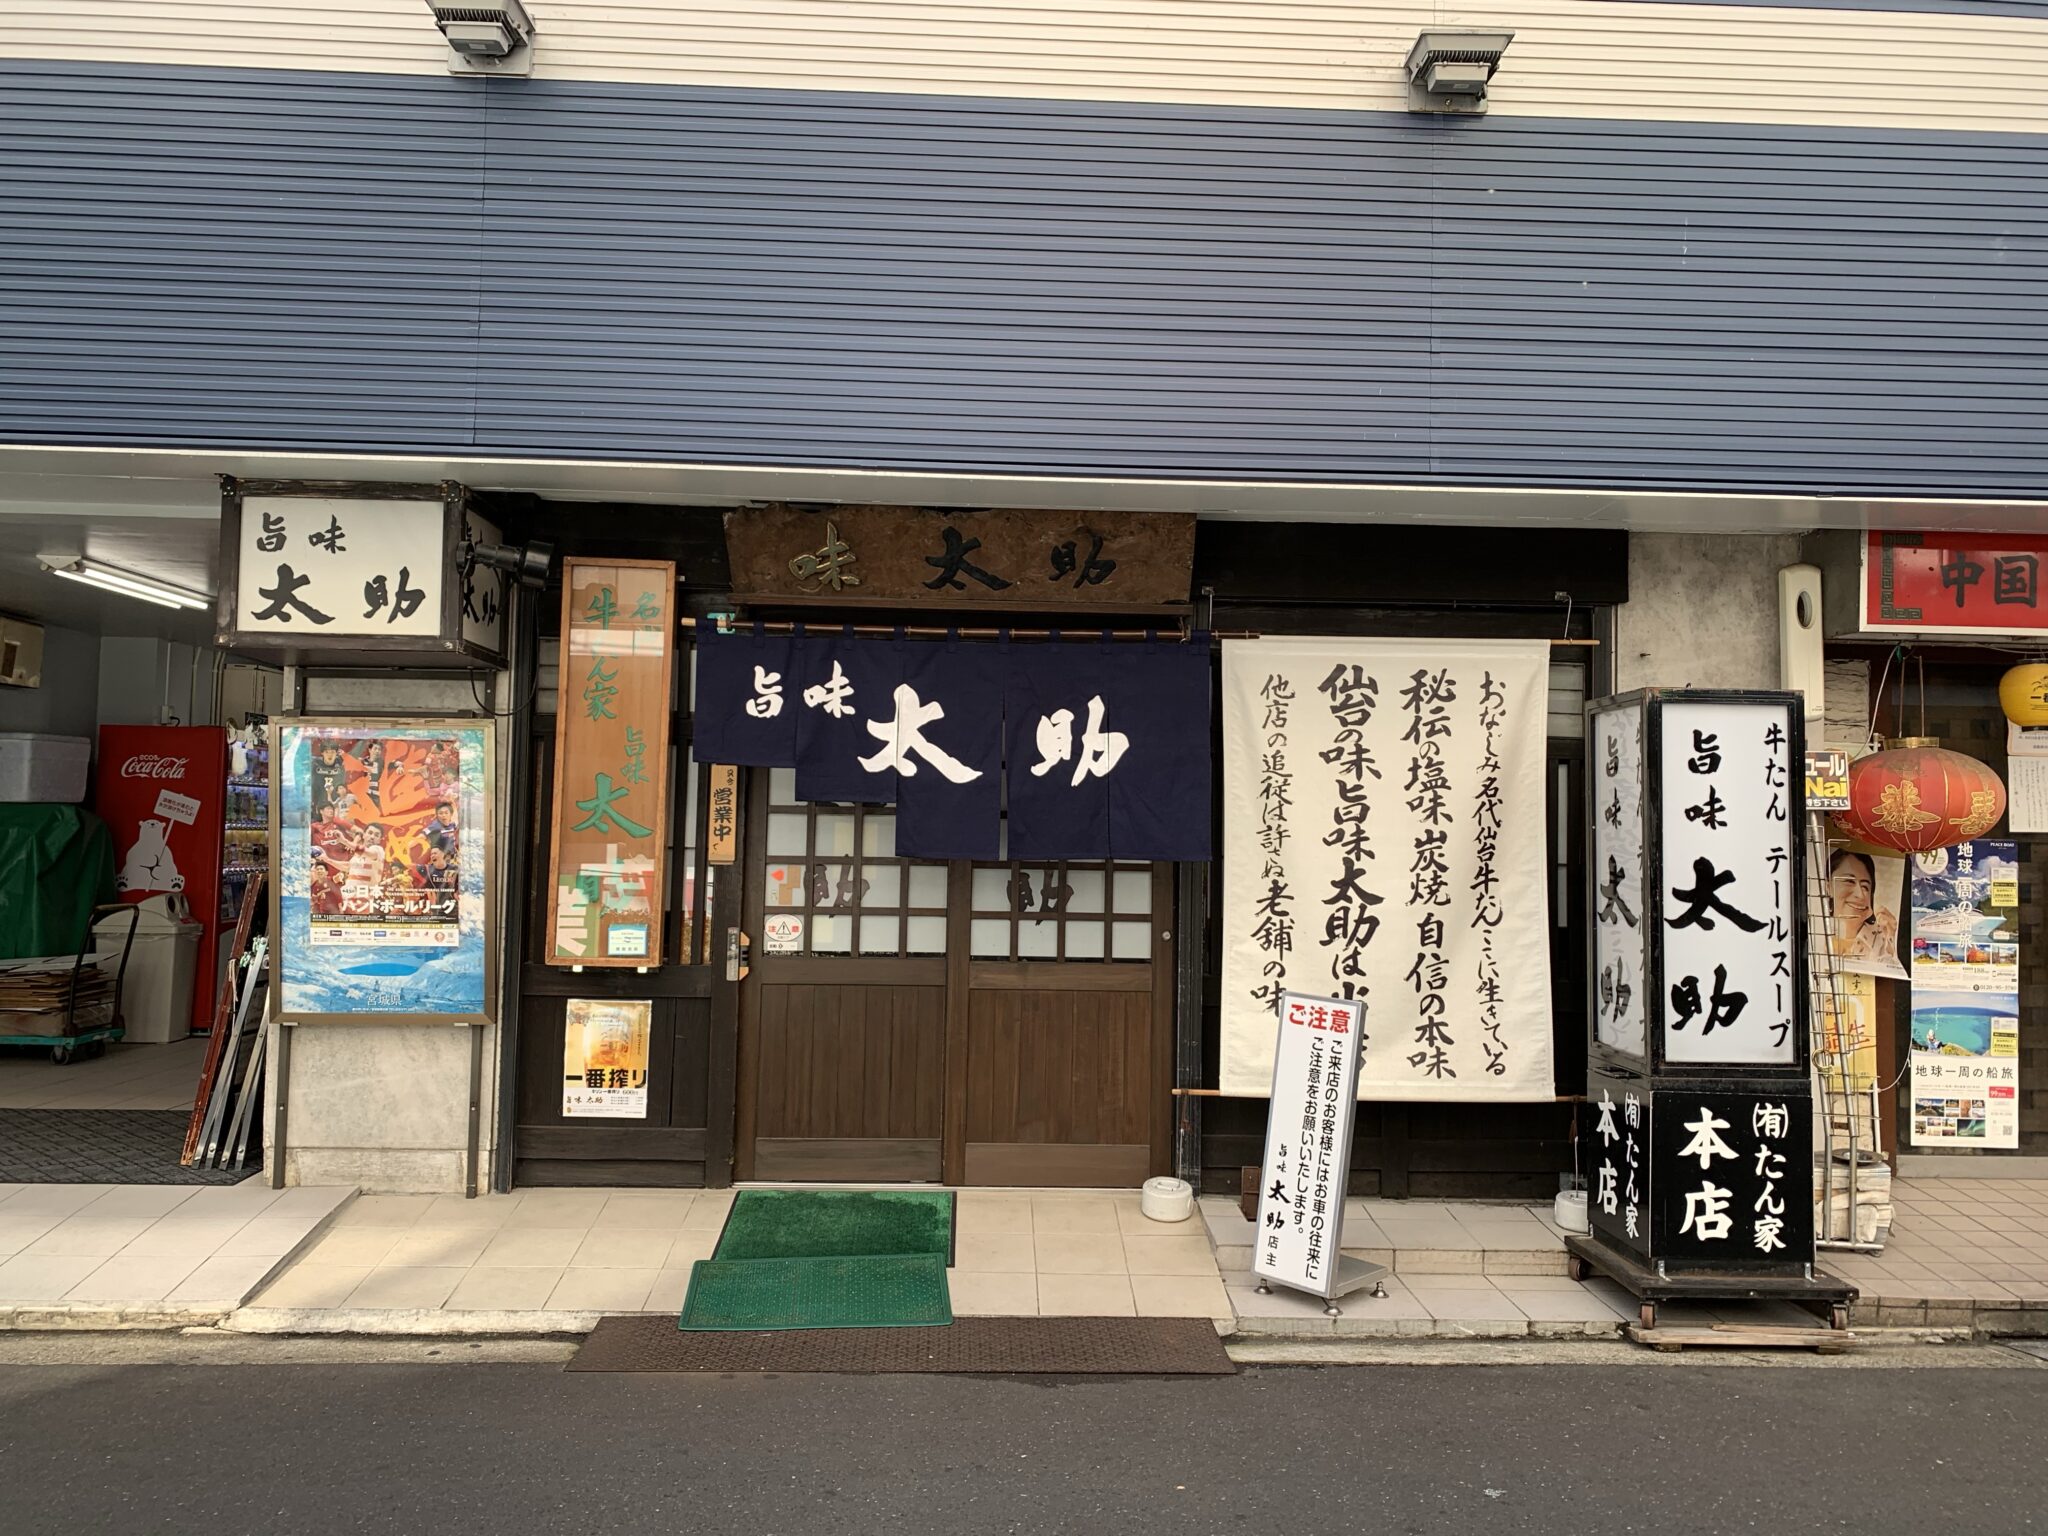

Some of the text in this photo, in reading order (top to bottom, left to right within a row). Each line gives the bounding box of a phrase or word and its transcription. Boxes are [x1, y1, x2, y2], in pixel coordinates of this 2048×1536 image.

[257, 512, 346, 554] 旨味
[251, 563, 426, 625] 太助
[1940, 553, 2040, 608] 中国
[121, 757, 190, 779] Coca-Cola
[713, 787, 733, 842] 営業中
[357, 885, 384, 898] 日本
[1318, 664, 1386, 1070] 仙台の味旨味太助は
[1764, 847, 1792, 1048] テールスープ
[1288, 1003, 1351, 1034] ご注意
[566, 1069, 647, 1088] 一番搾り
[1915, 1065, 2013, 1080] 地球一周の船旅
[1293, 1036, 1324, 1234] ご注意をお願いいたします。
[1305, 1040, 1344, 1281] ご来店のお客様にはお車の往来に
[1596, 1088, 1620, 1216] 本店
[1677, 1106, 1740, 1241] 本店
